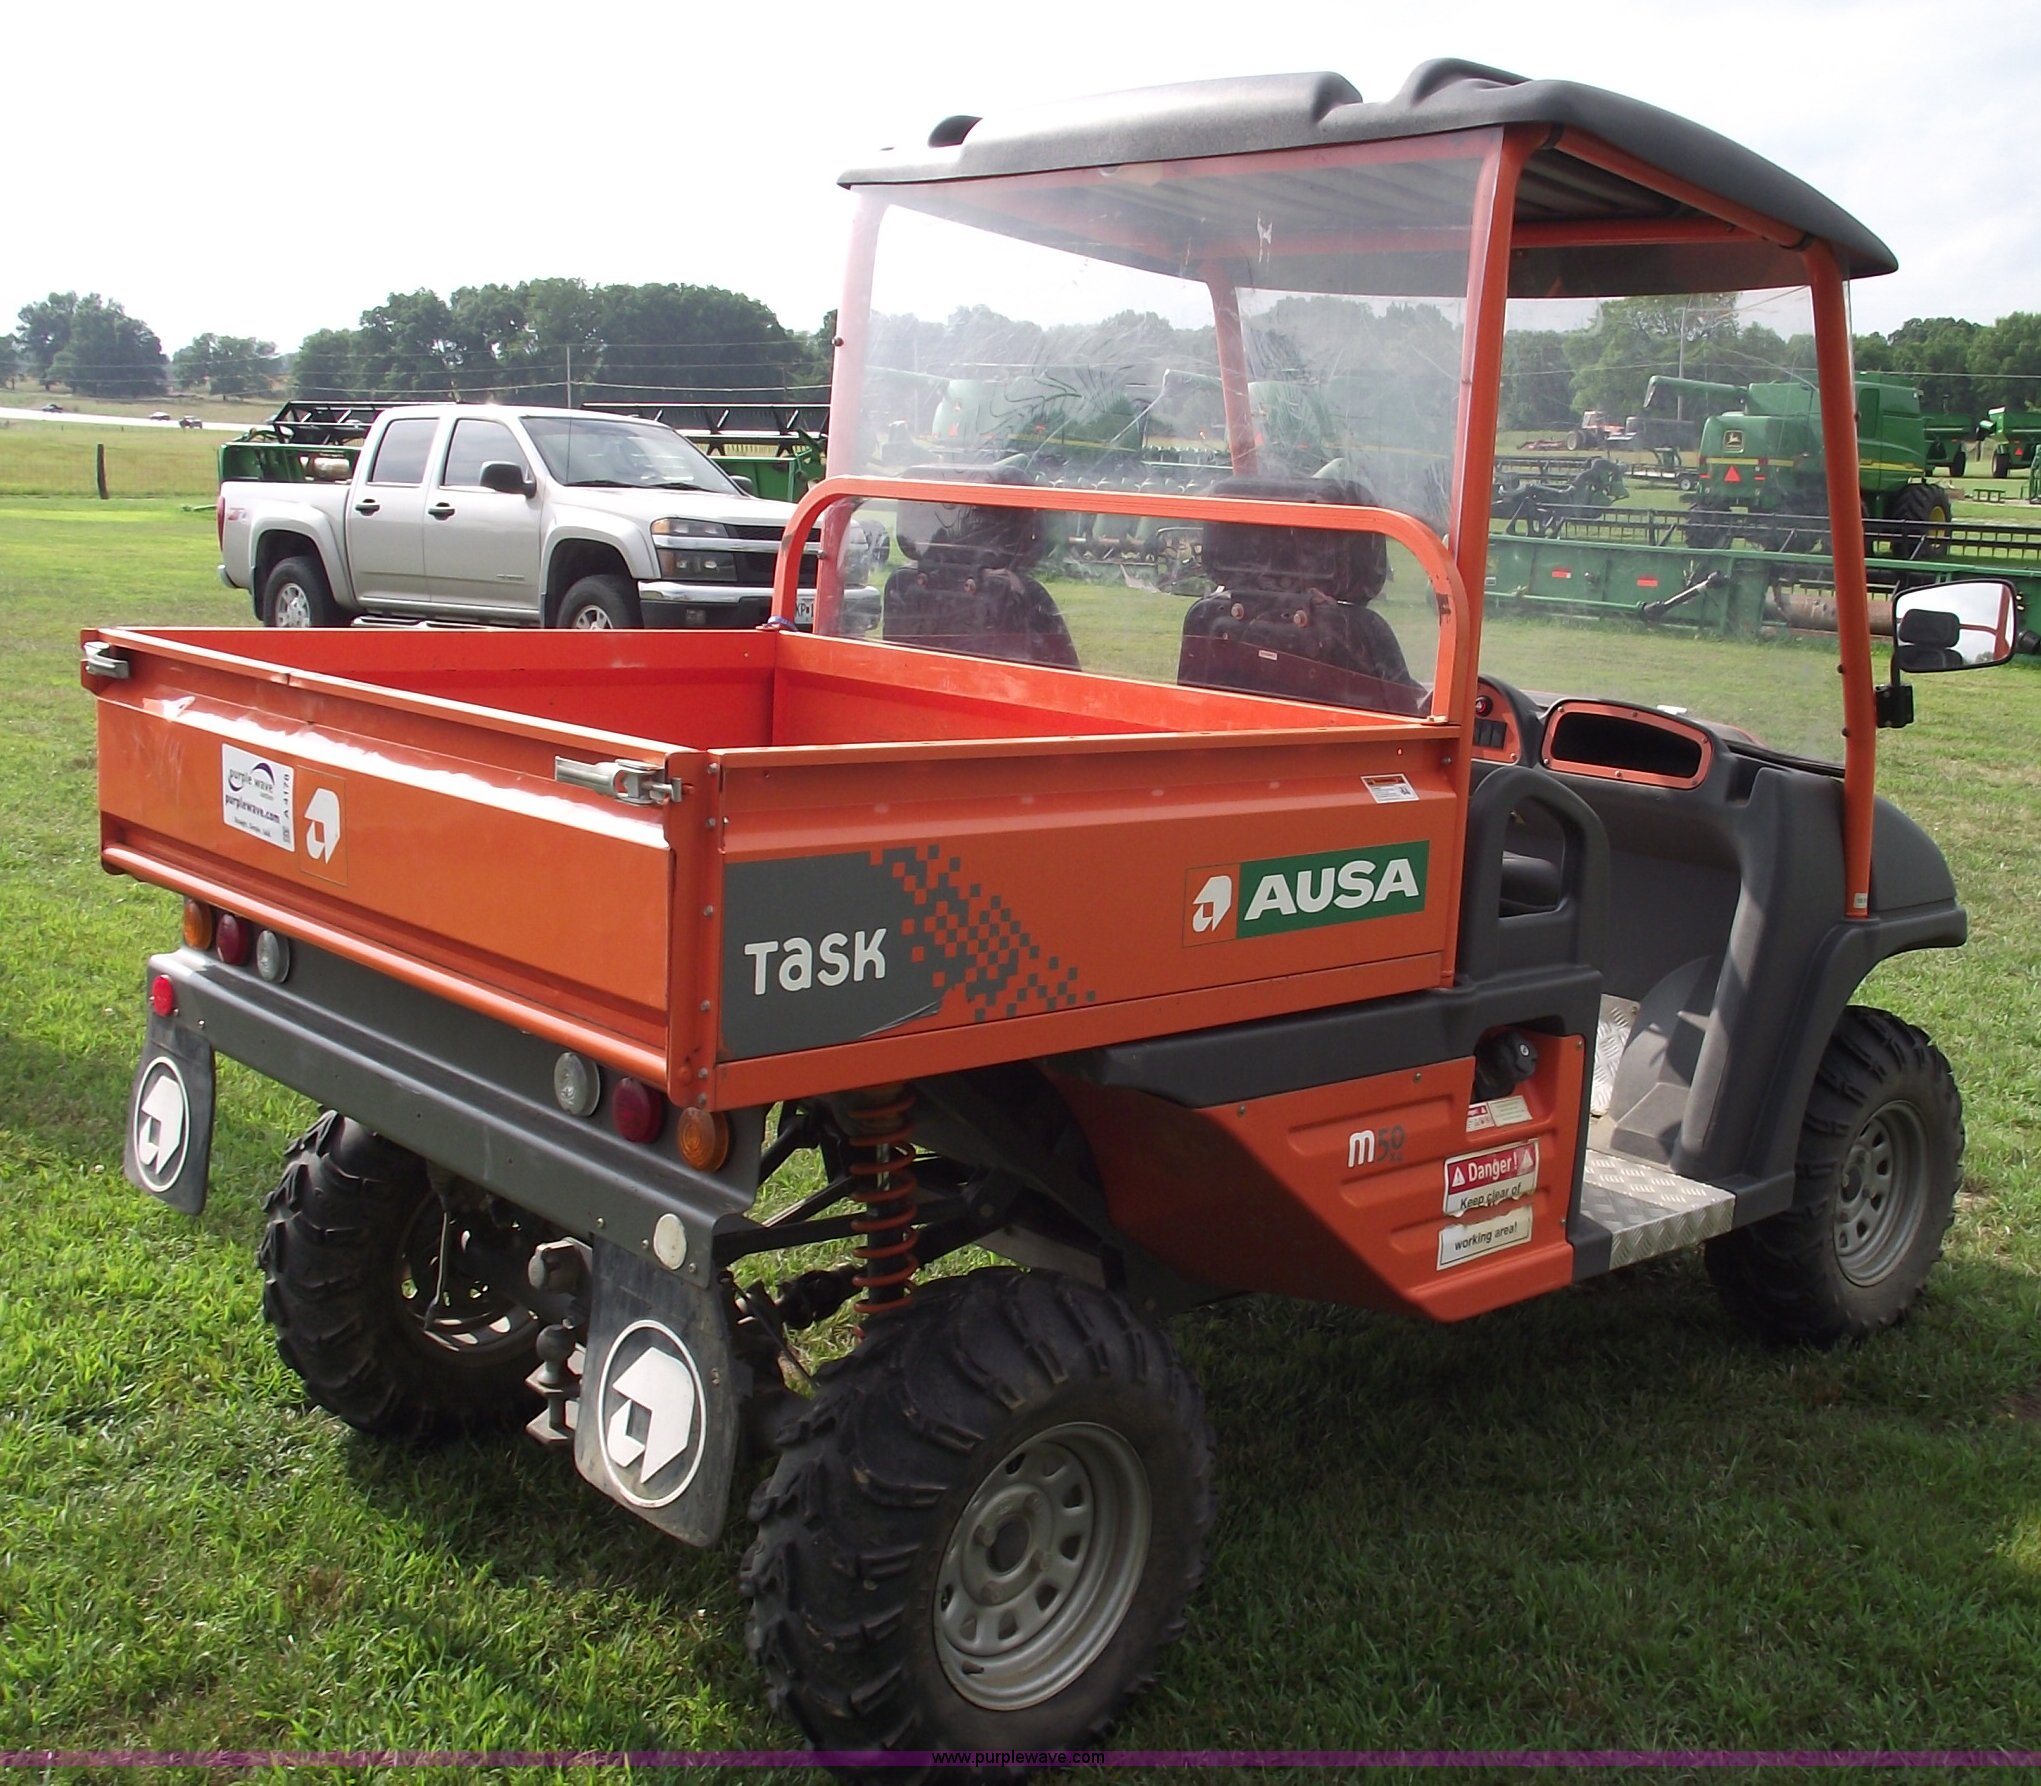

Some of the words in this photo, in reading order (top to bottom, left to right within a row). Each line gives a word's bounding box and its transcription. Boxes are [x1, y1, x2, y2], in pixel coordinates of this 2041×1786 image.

[229, 768, 252, 786] purple
[254, 779, 274, 793] wave
[225, 794, 281, 824] purplewave.com
[1244, 858, 1420, 921] AUSA
[1460, 1194, 1486, 1209] Keep
[1486, 1188, 1510, 1203] clear
[1511, 1182, 1521, 1195] of
[1454, 1230, 1493, 1251] working
